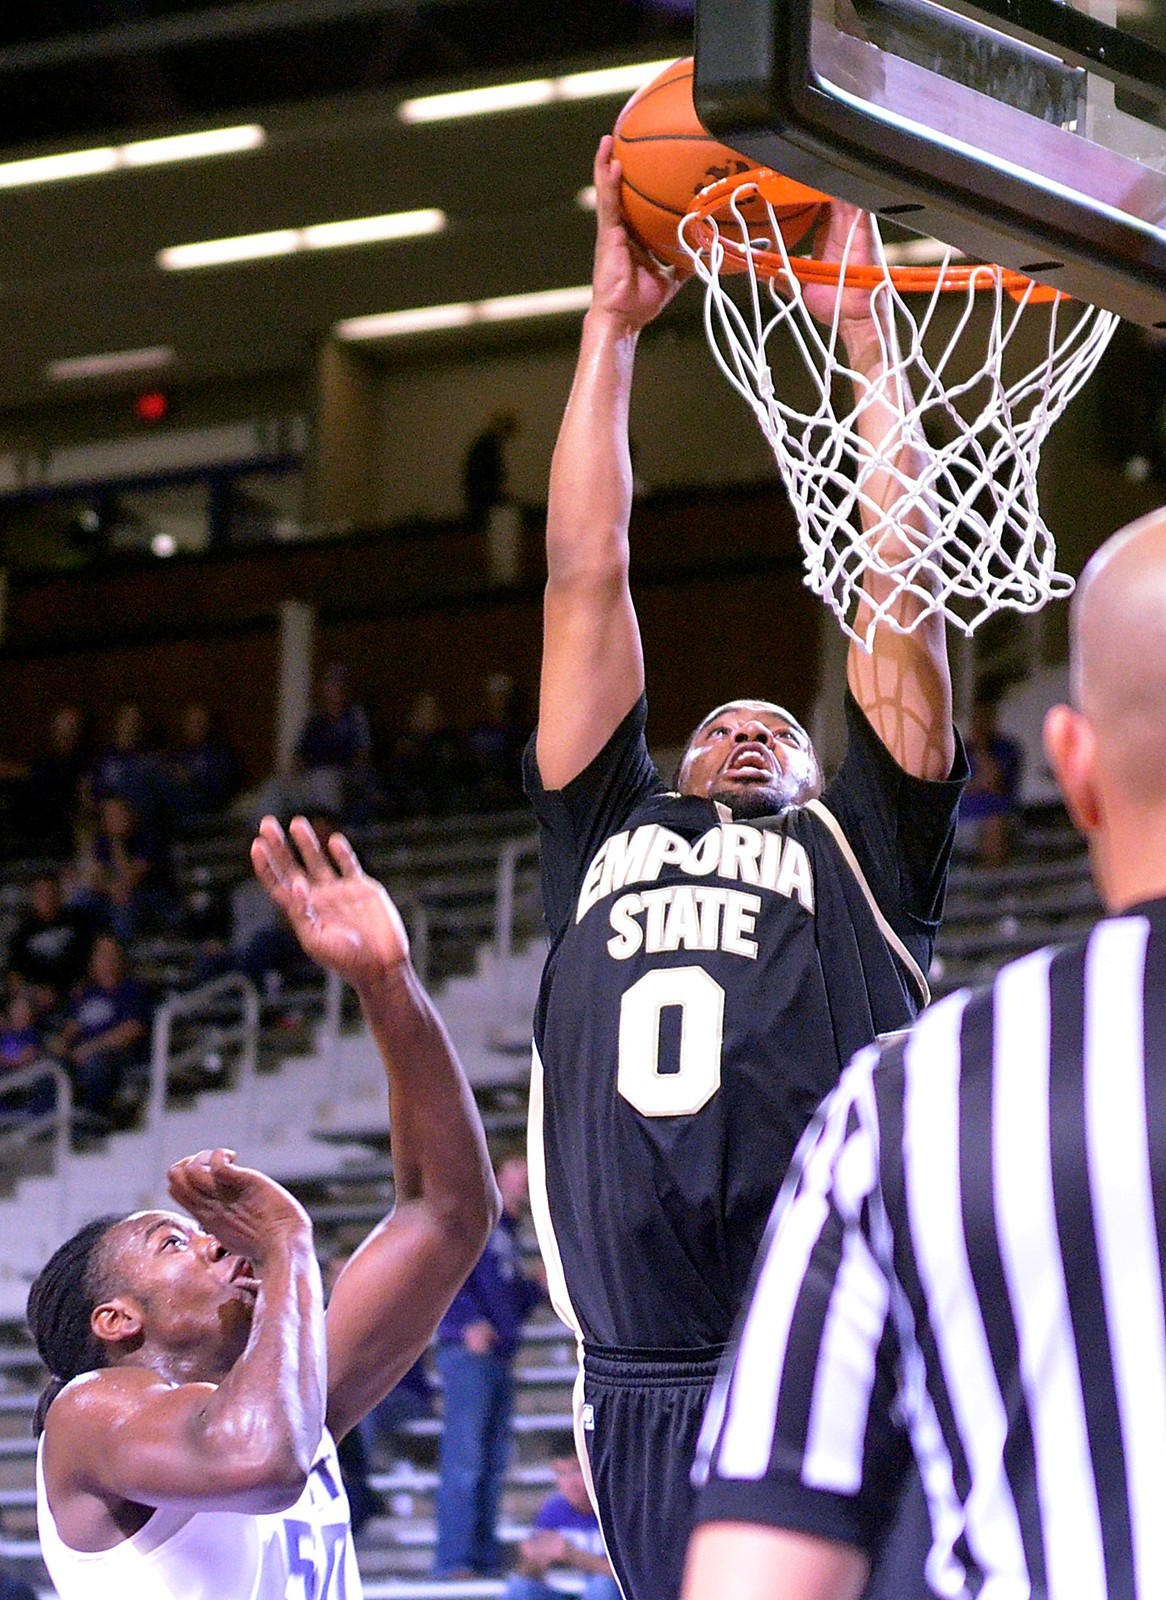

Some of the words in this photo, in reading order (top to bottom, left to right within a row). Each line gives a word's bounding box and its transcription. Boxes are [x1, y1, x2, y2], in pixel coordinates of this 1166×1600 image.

[576, 823, 815, 925] EMPORIA
[607, 885, 761, 960] STATE
[617, 965, 725, 1117] 0
